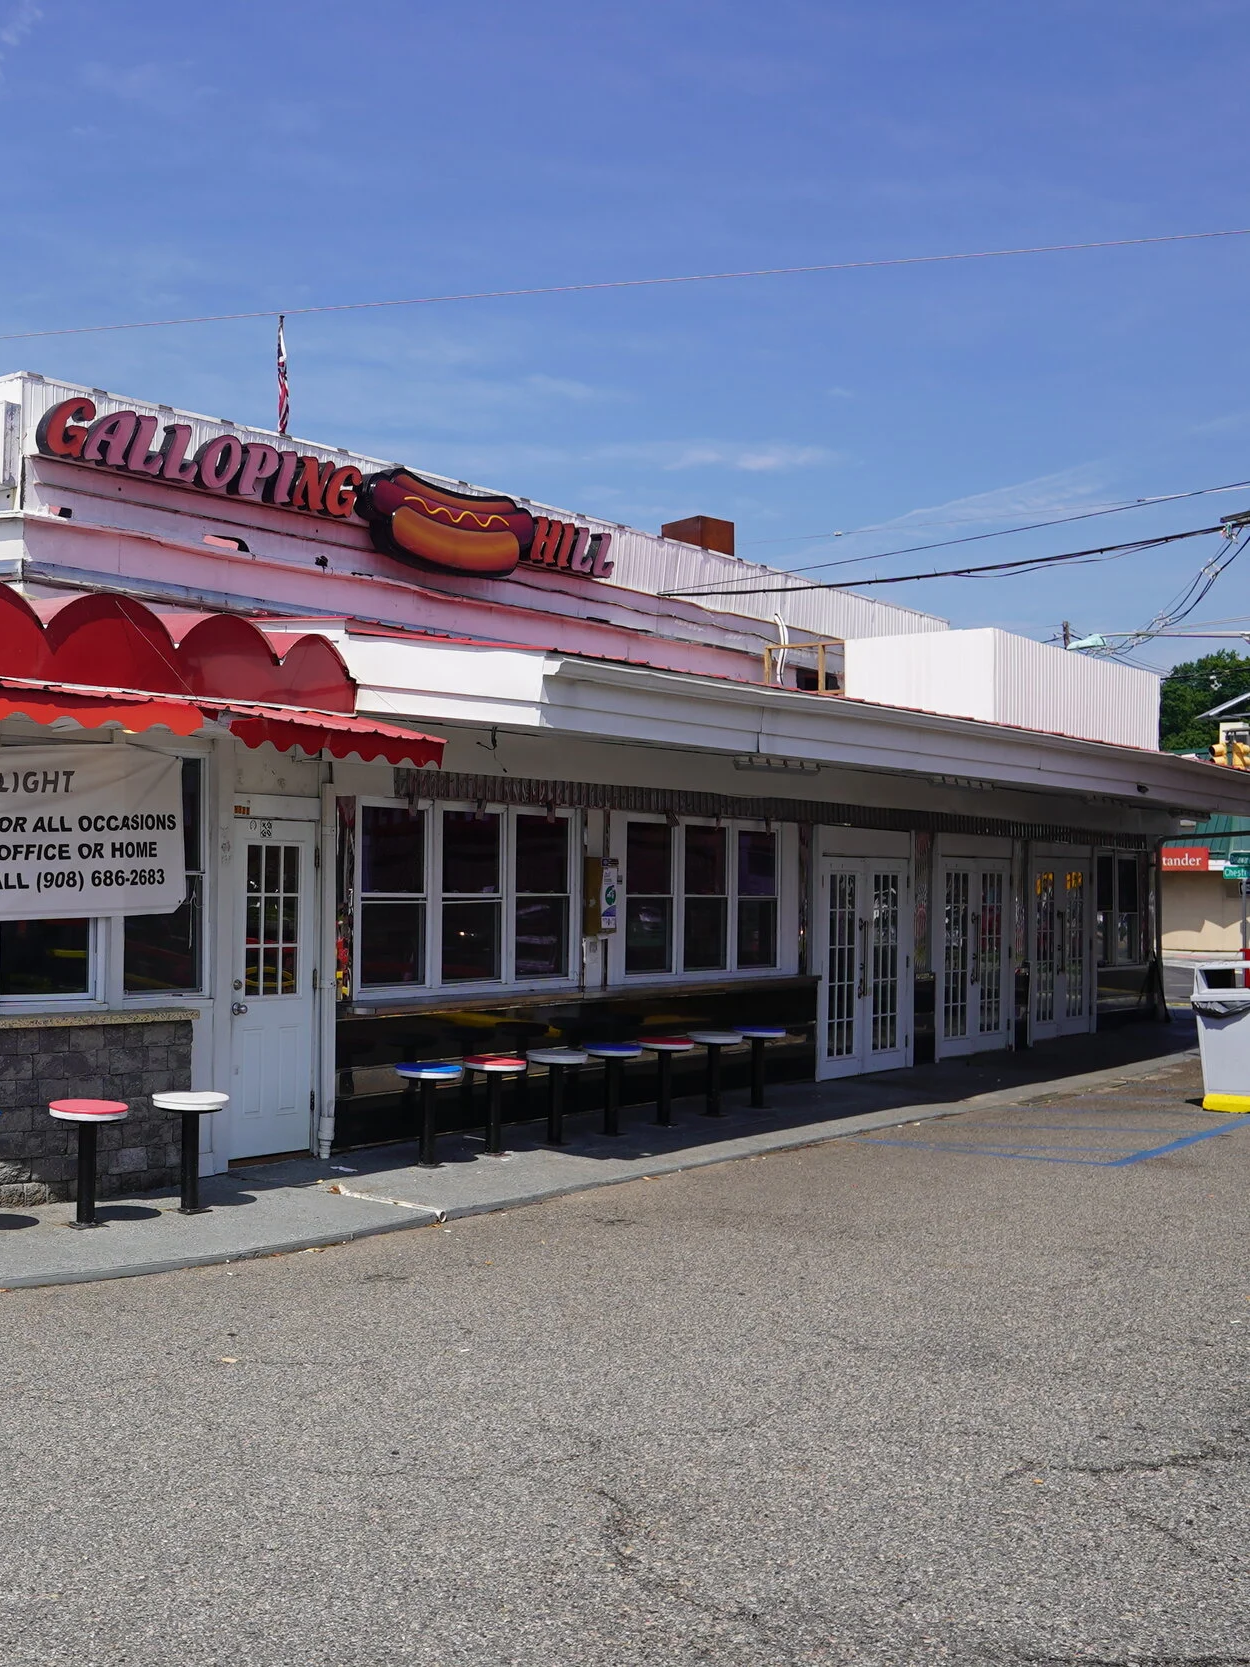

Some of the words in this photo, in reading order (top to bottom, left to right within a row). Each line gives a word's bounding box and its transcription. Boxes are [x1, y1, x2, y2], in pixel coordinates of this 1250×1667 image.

[36, 397, 363, 518] GALLOPING
[531, 516, 614, 578] HILL
[32, 815, 72, 833] ALL
[78, 814, 177, 832] OCCASIONS
[77, 843, 105, 860] OR
[111, 841, 158, 859] HOME
[36, 870, 85, 893] (908)
[91, 868, 166, 887] 686-2683
